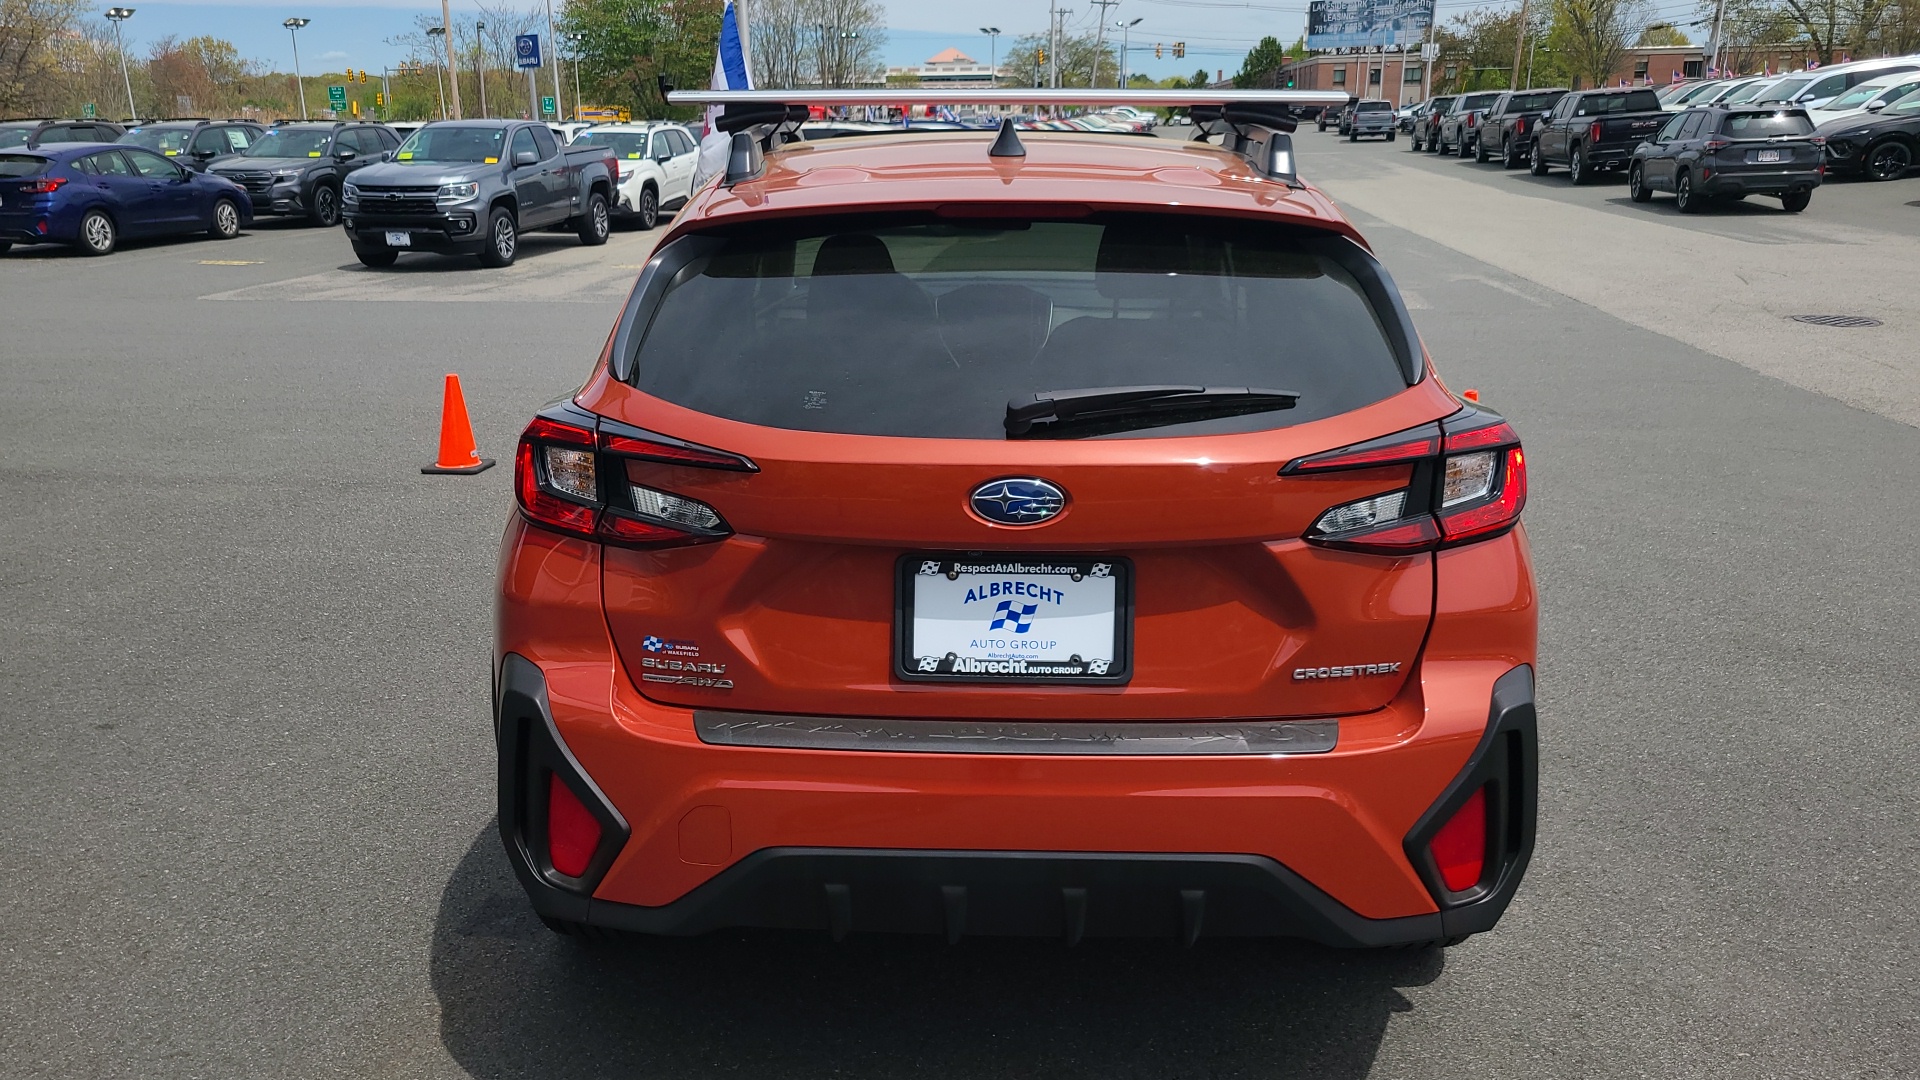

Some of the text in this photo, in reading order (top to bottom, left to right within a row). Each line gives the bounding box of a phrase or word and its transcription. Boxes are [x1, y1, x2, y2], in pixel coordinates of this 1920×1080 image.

[1312, 2, 1346, 12] LAKESIDE
[1323, 12, 1354, 22] LEASING
[953, 563, 1077, 575] RespectAtAlbrecht.com
[963, 581, 1064, 605] ALBRECHT
[969, 639, 1057, 650] AUTO GROUP
[987, 652, 1039, 660] AlbrechtAuto.com
[641, 657, 727, 674] SUBARU
[952, 657, 1083, 675] Albrecht AUTO GROUP
[1292, 662, 1402, 680] CROSSTREK
[676, 676, 734, 689] AWD
